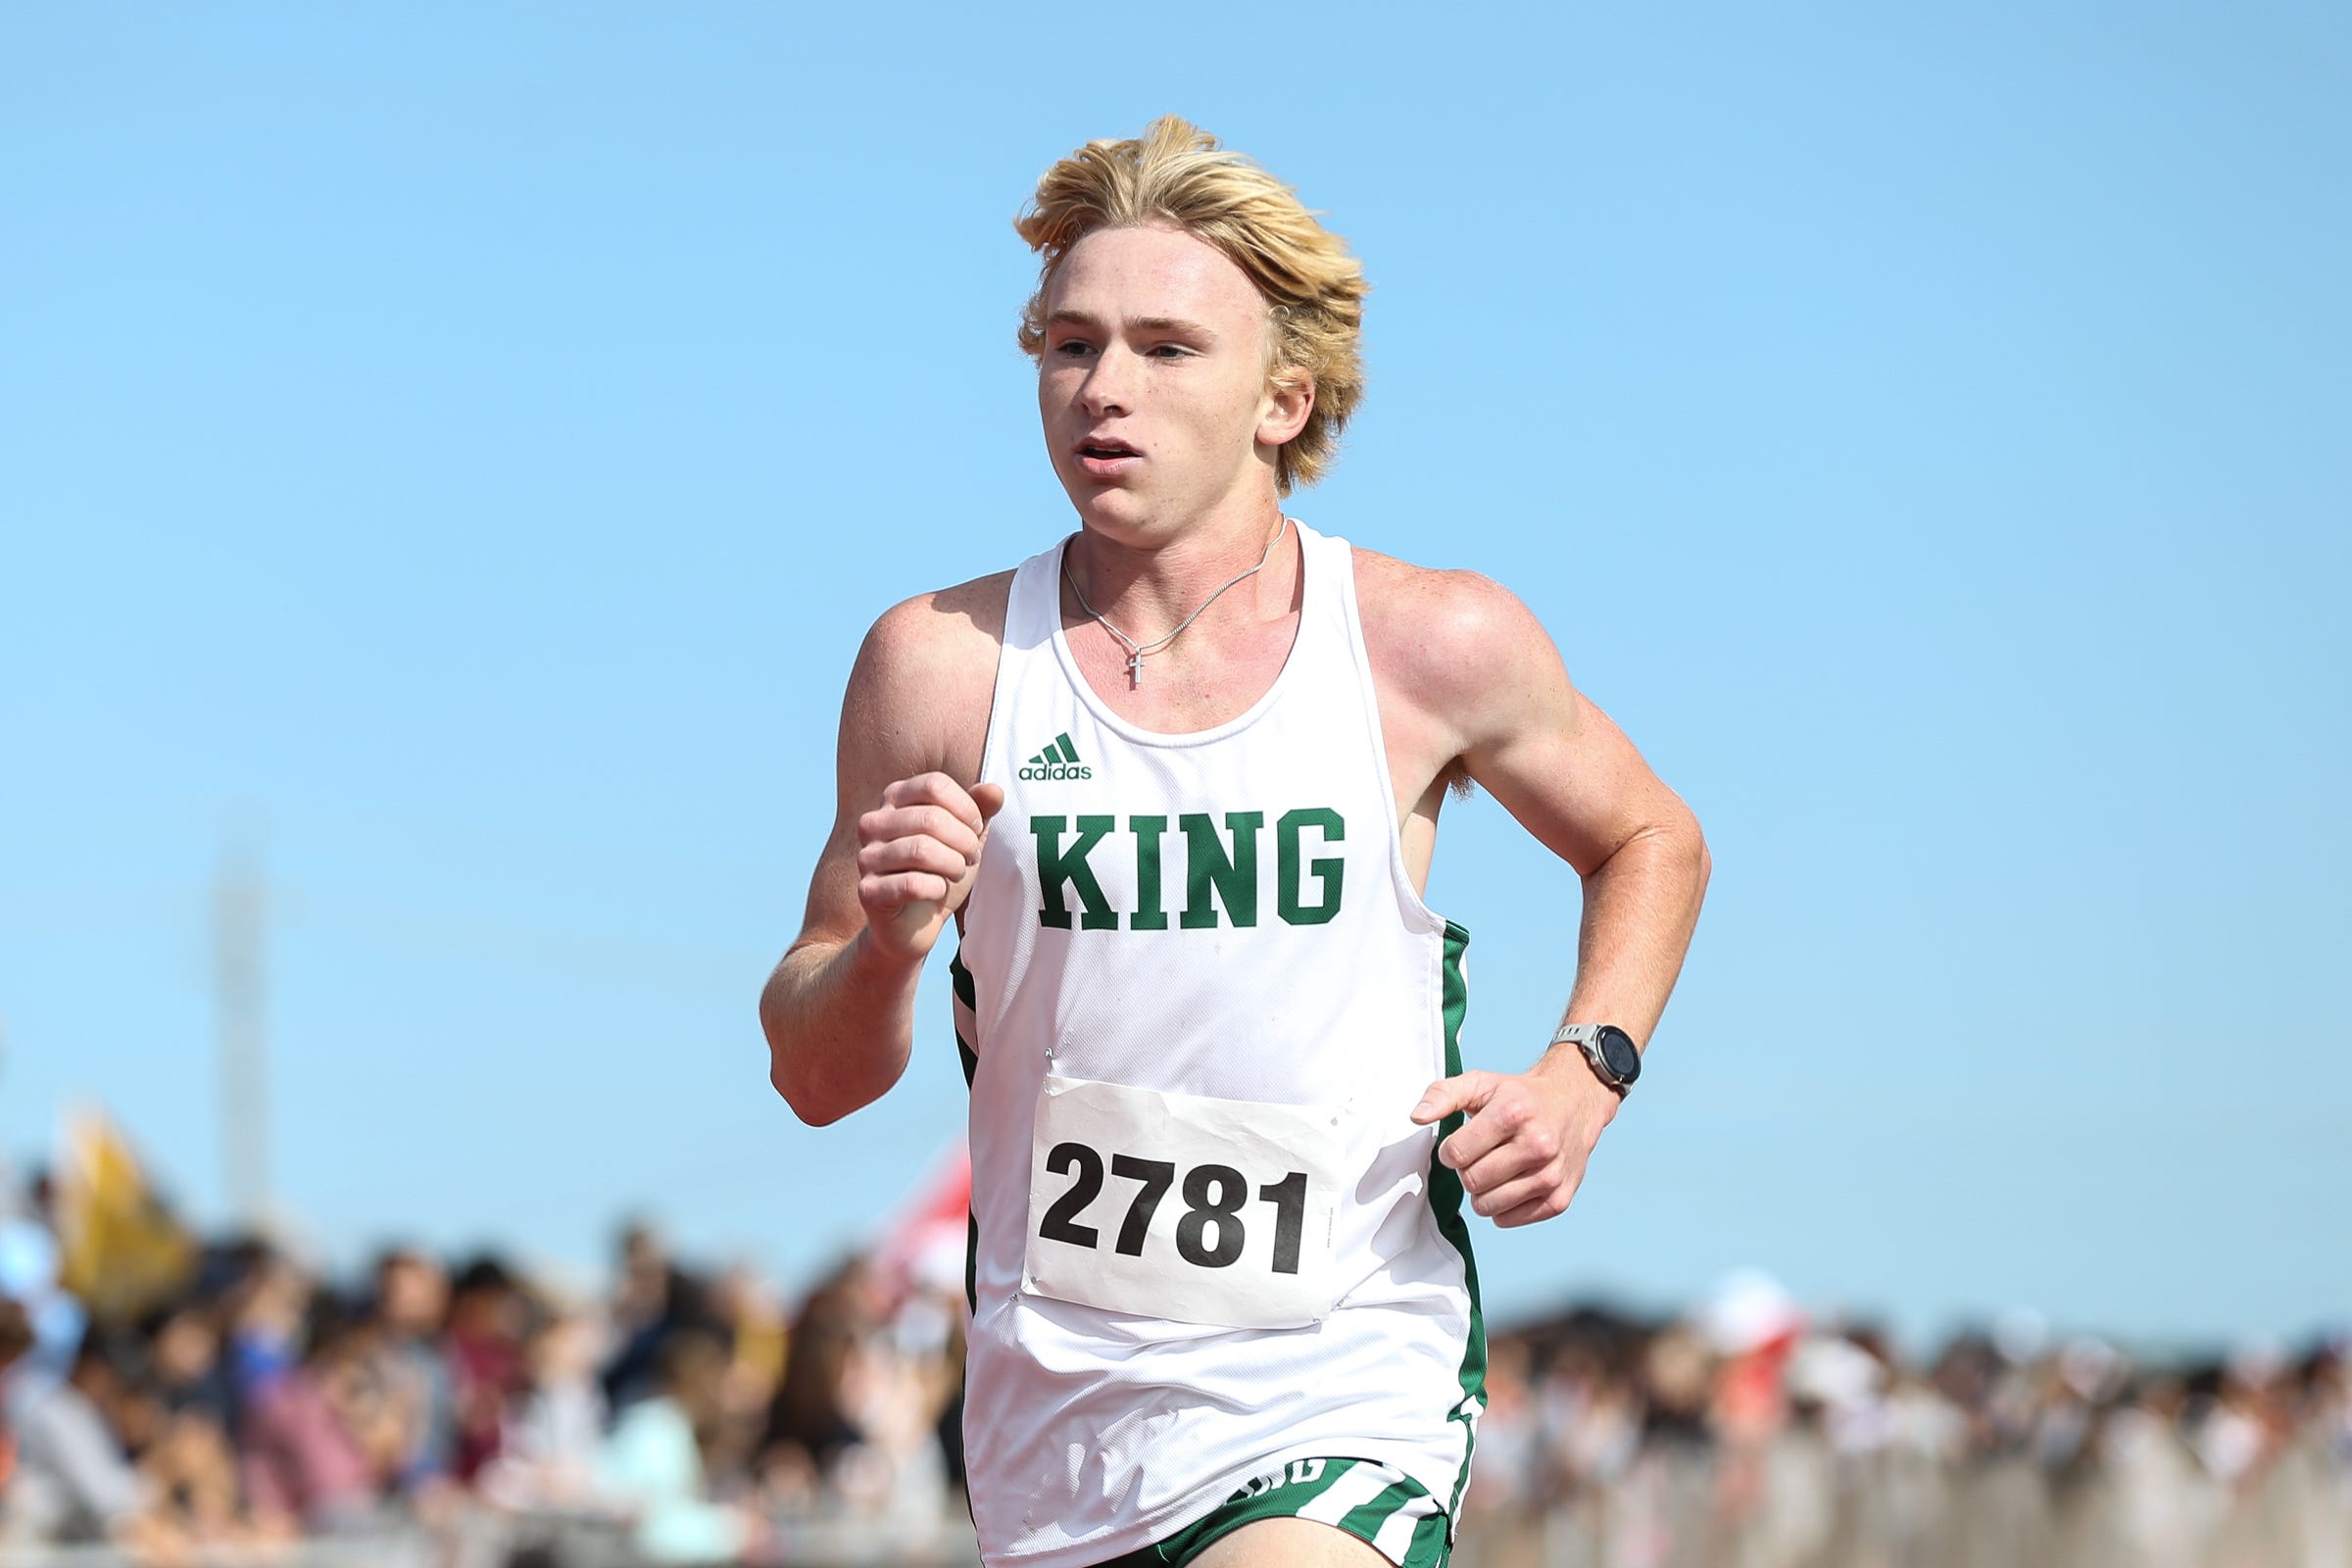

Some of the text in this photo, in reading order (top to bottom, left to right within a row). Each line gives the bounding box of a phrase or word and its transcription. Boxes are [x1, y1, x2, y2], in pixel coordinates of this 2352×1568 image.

[1018, 761, 1092, 781] adidas
[1030, 808, 1346, 931] KING
[1039, 1142, 1308, 1275] 2781
